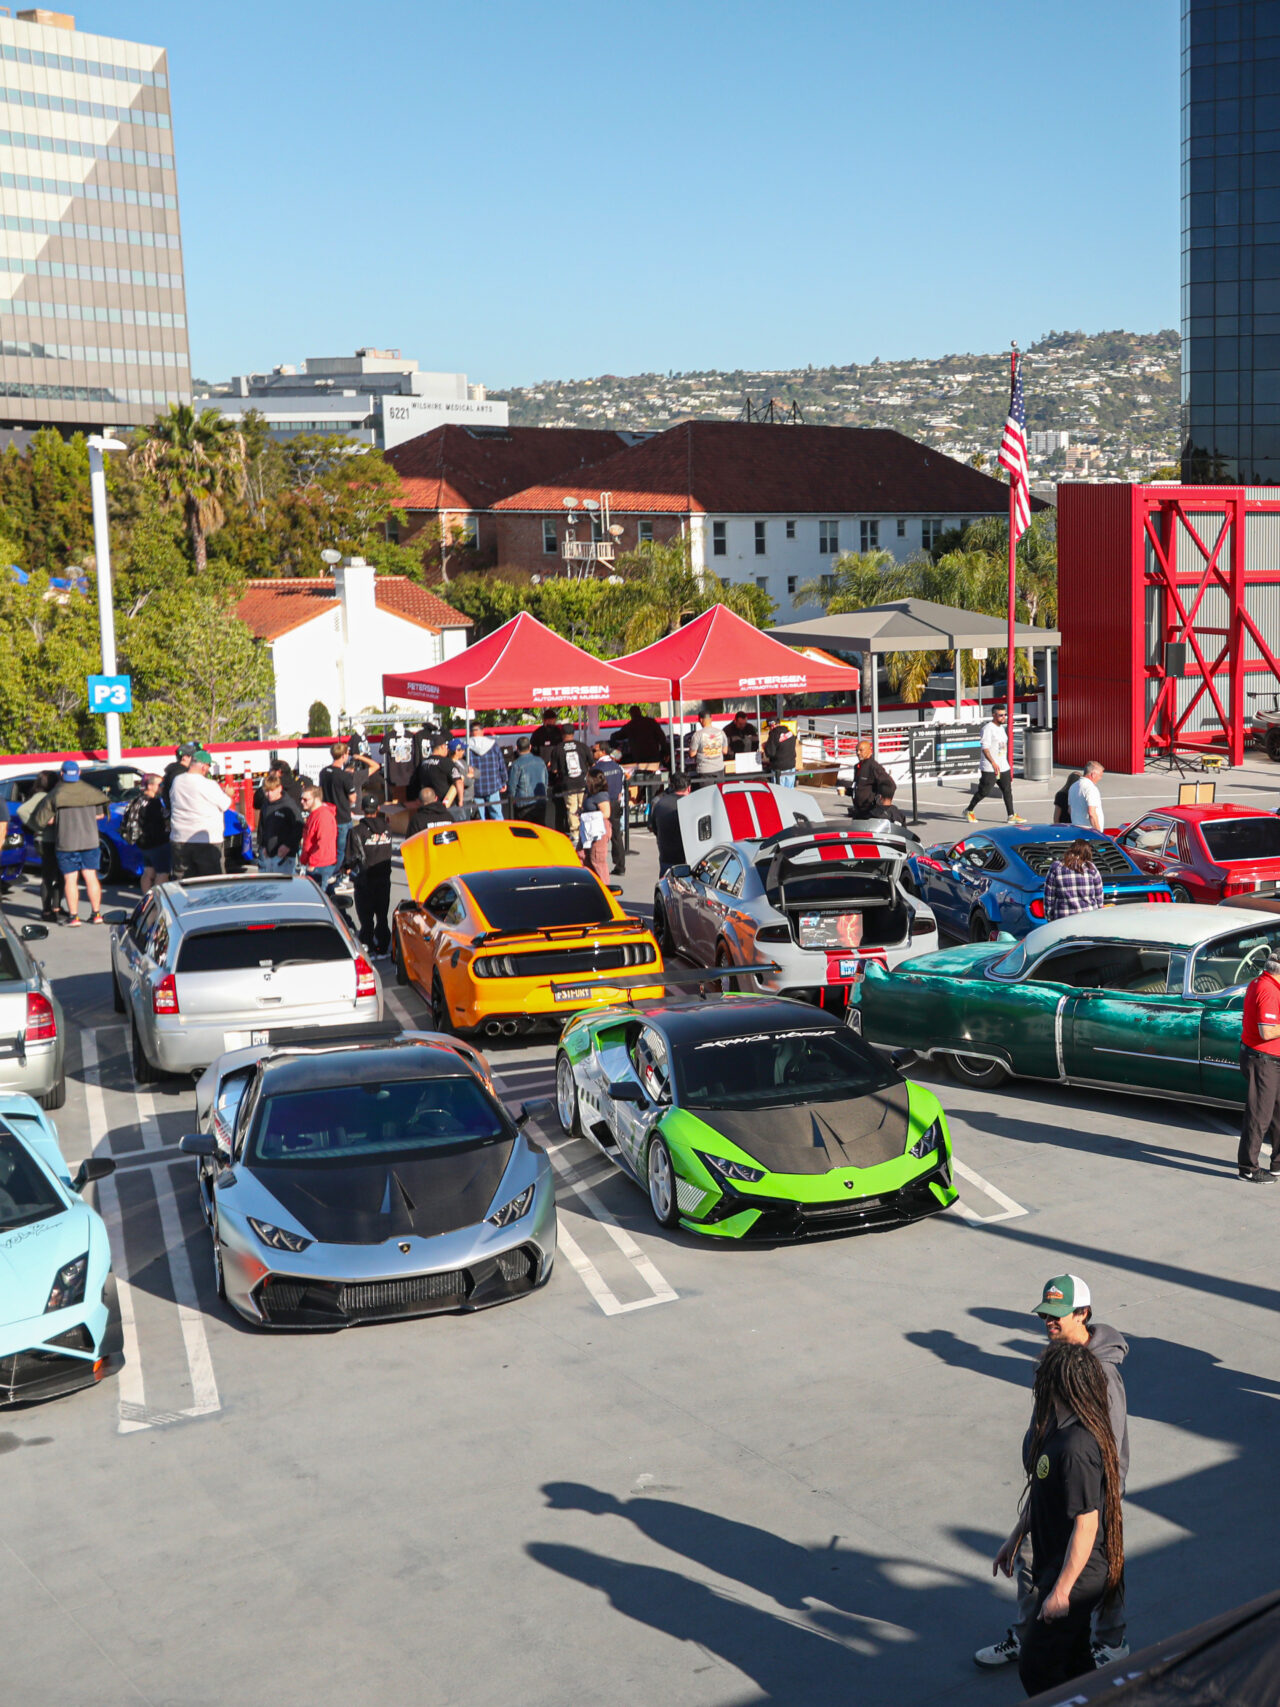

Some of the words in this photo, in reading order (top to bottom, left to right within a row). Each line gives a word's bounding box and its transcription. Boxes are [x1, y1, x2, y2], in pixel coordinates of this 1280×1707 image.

[390, 407, 410, 419] 6221
[412, 402, 442, 410] WILSHIRE
[445, 403, 473, 412] MEDICAL
[476, 405, 493, 413] ARTS
[738, 675, 807, 687] PETERSEN
[407, 682, 440, 694] PETERSEN
[532, 685, 609, 696] PETERSEN
[94, 685, 126, 704] P3
